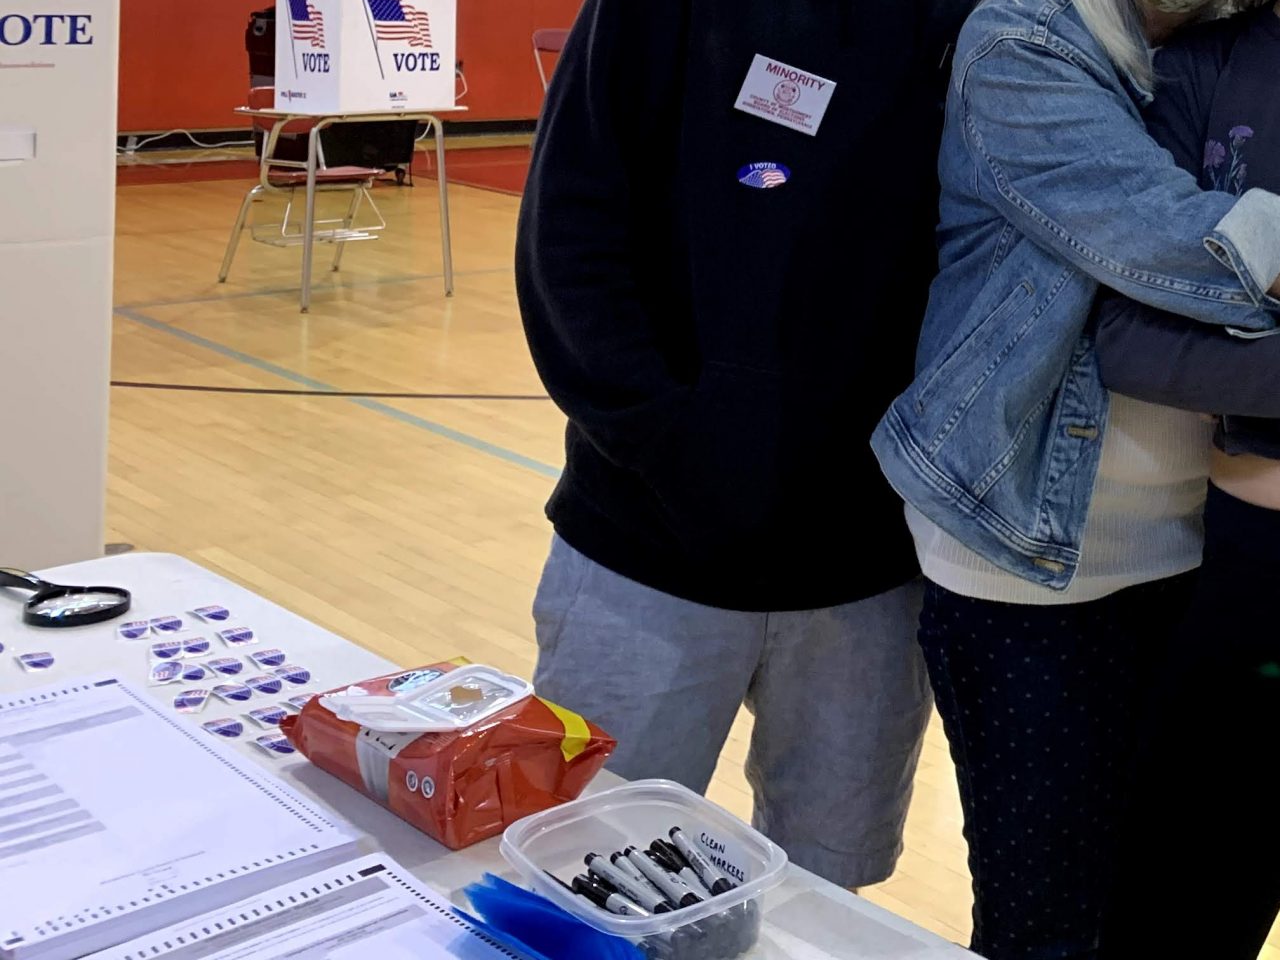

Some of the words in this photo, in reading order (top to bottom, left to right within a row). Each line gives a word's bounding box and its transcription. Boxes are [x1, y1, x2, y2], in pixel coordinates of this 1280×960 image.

[302, 52, 330, 73] VOTE
[393, 52, 440, 72] VOTE
[765, 62, 826, 91] MINORITY
[700, 832, 726, 854] CLEAN
[710, 853, 745, 882] MARKERS
